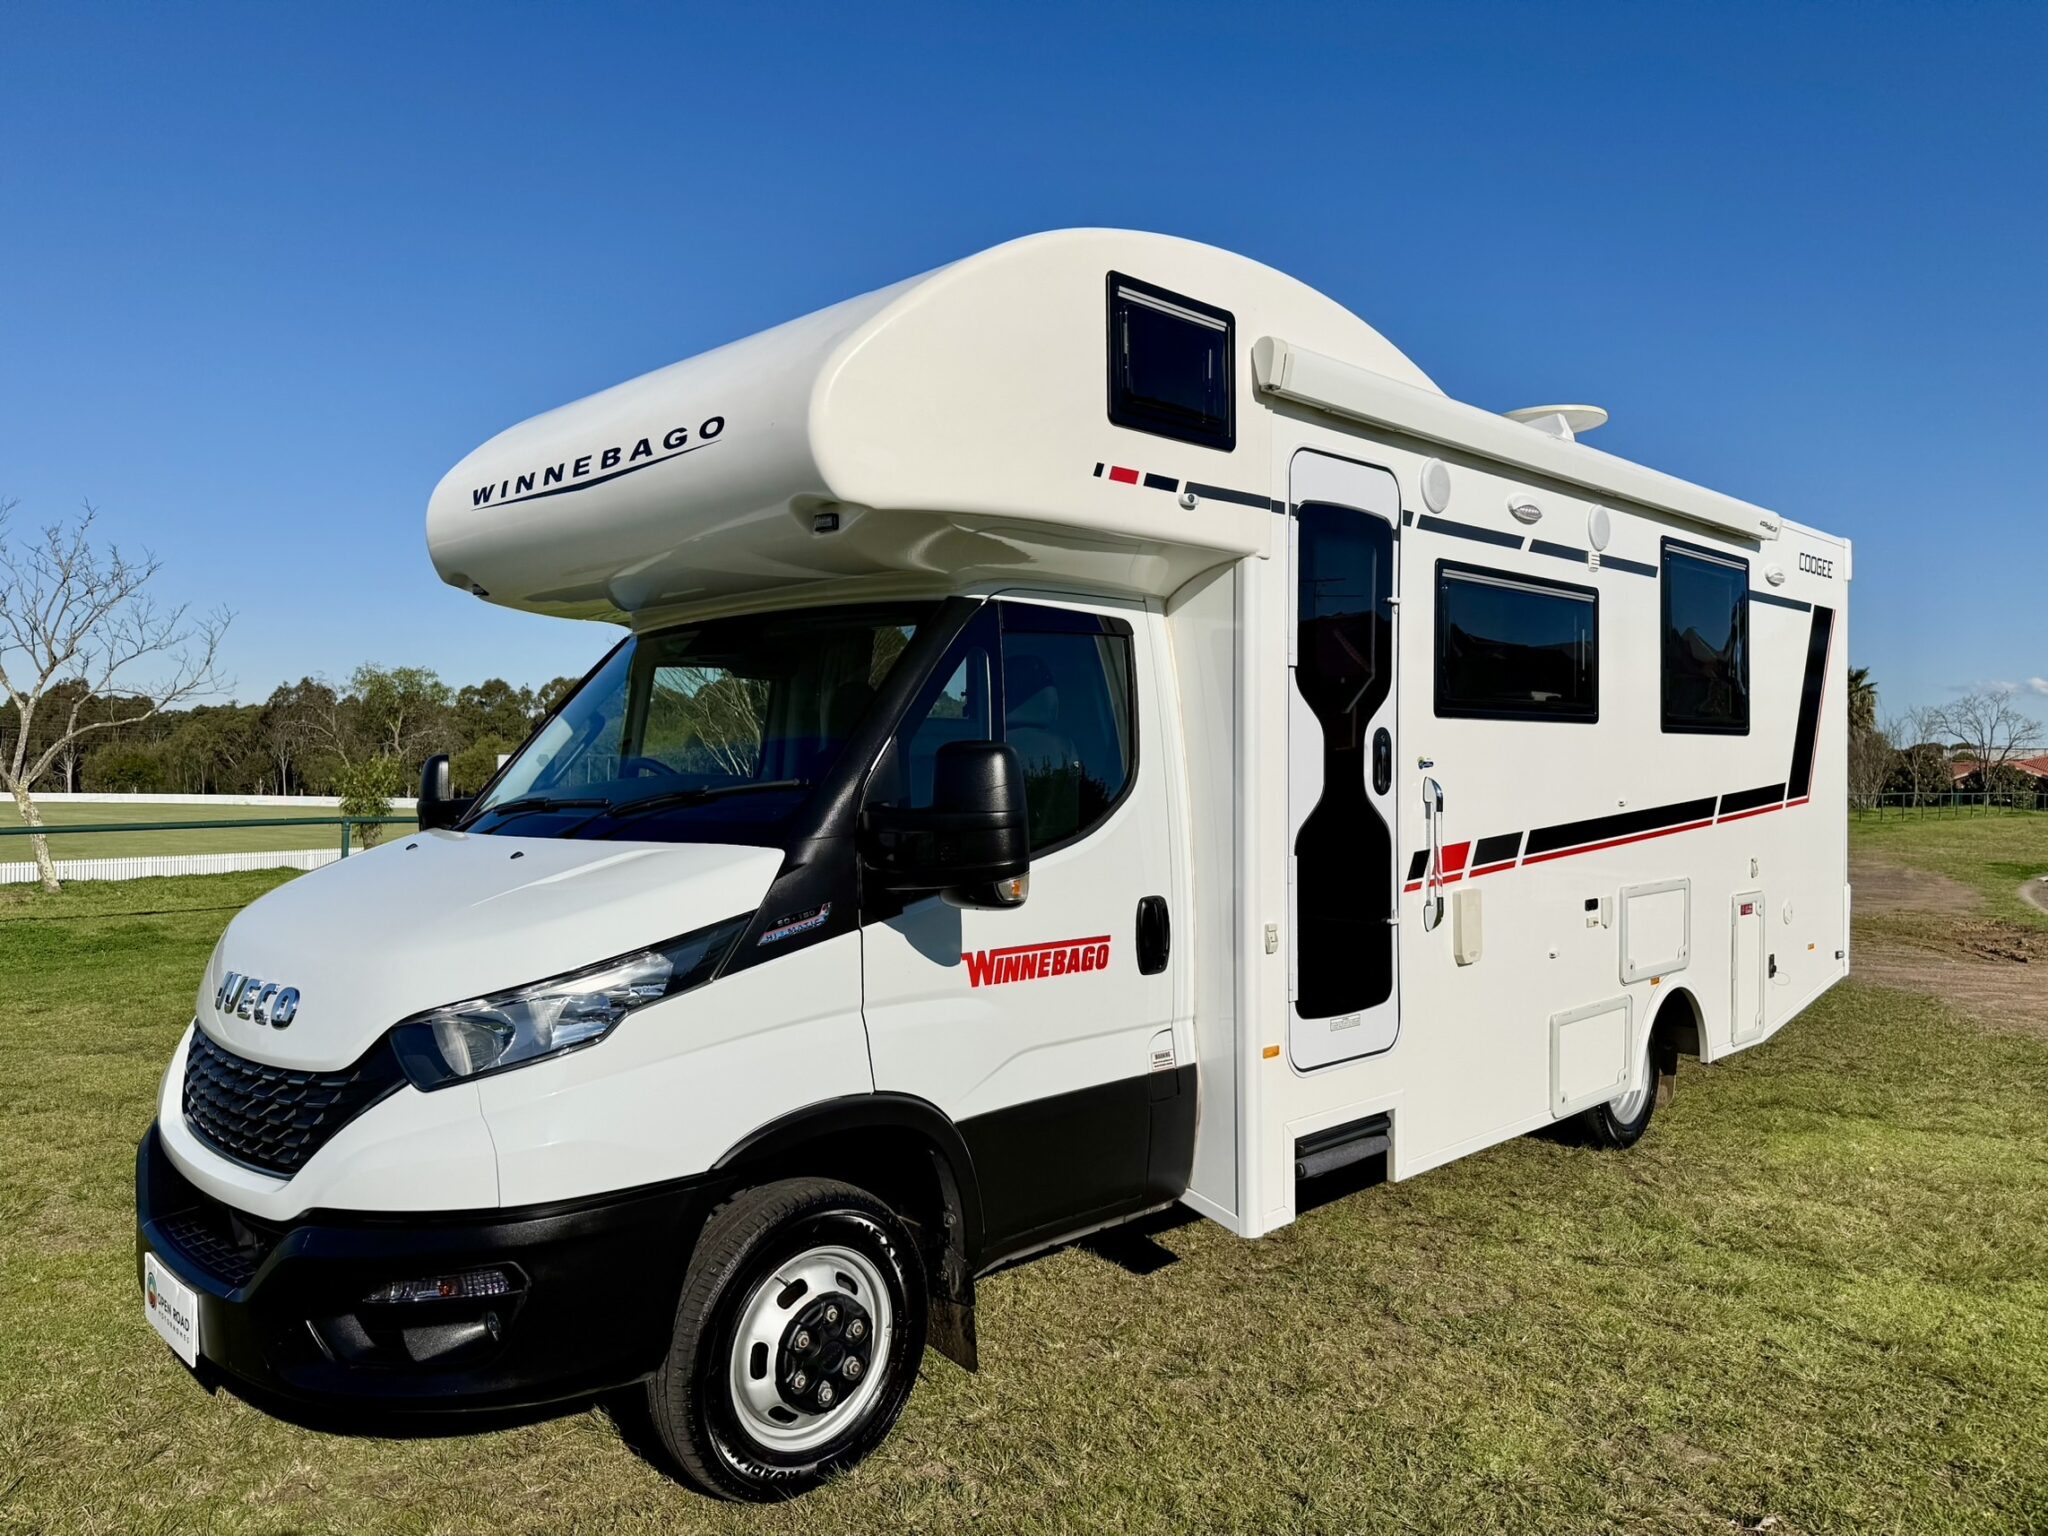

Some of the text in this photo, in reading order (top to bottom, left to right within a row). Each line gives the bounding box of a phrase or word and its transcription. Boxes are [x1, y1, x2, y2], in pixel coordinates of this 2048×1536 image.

[472, 415, 726, 506] WINNEBAGO
[1799, 552, 1834, 579] COOGEE
[962, 934, 1112, 988] WINNEBAGO
[214, 971, 301, 1031] IVECO
[157, 1292, 190, 1332] OPEN ROAD
